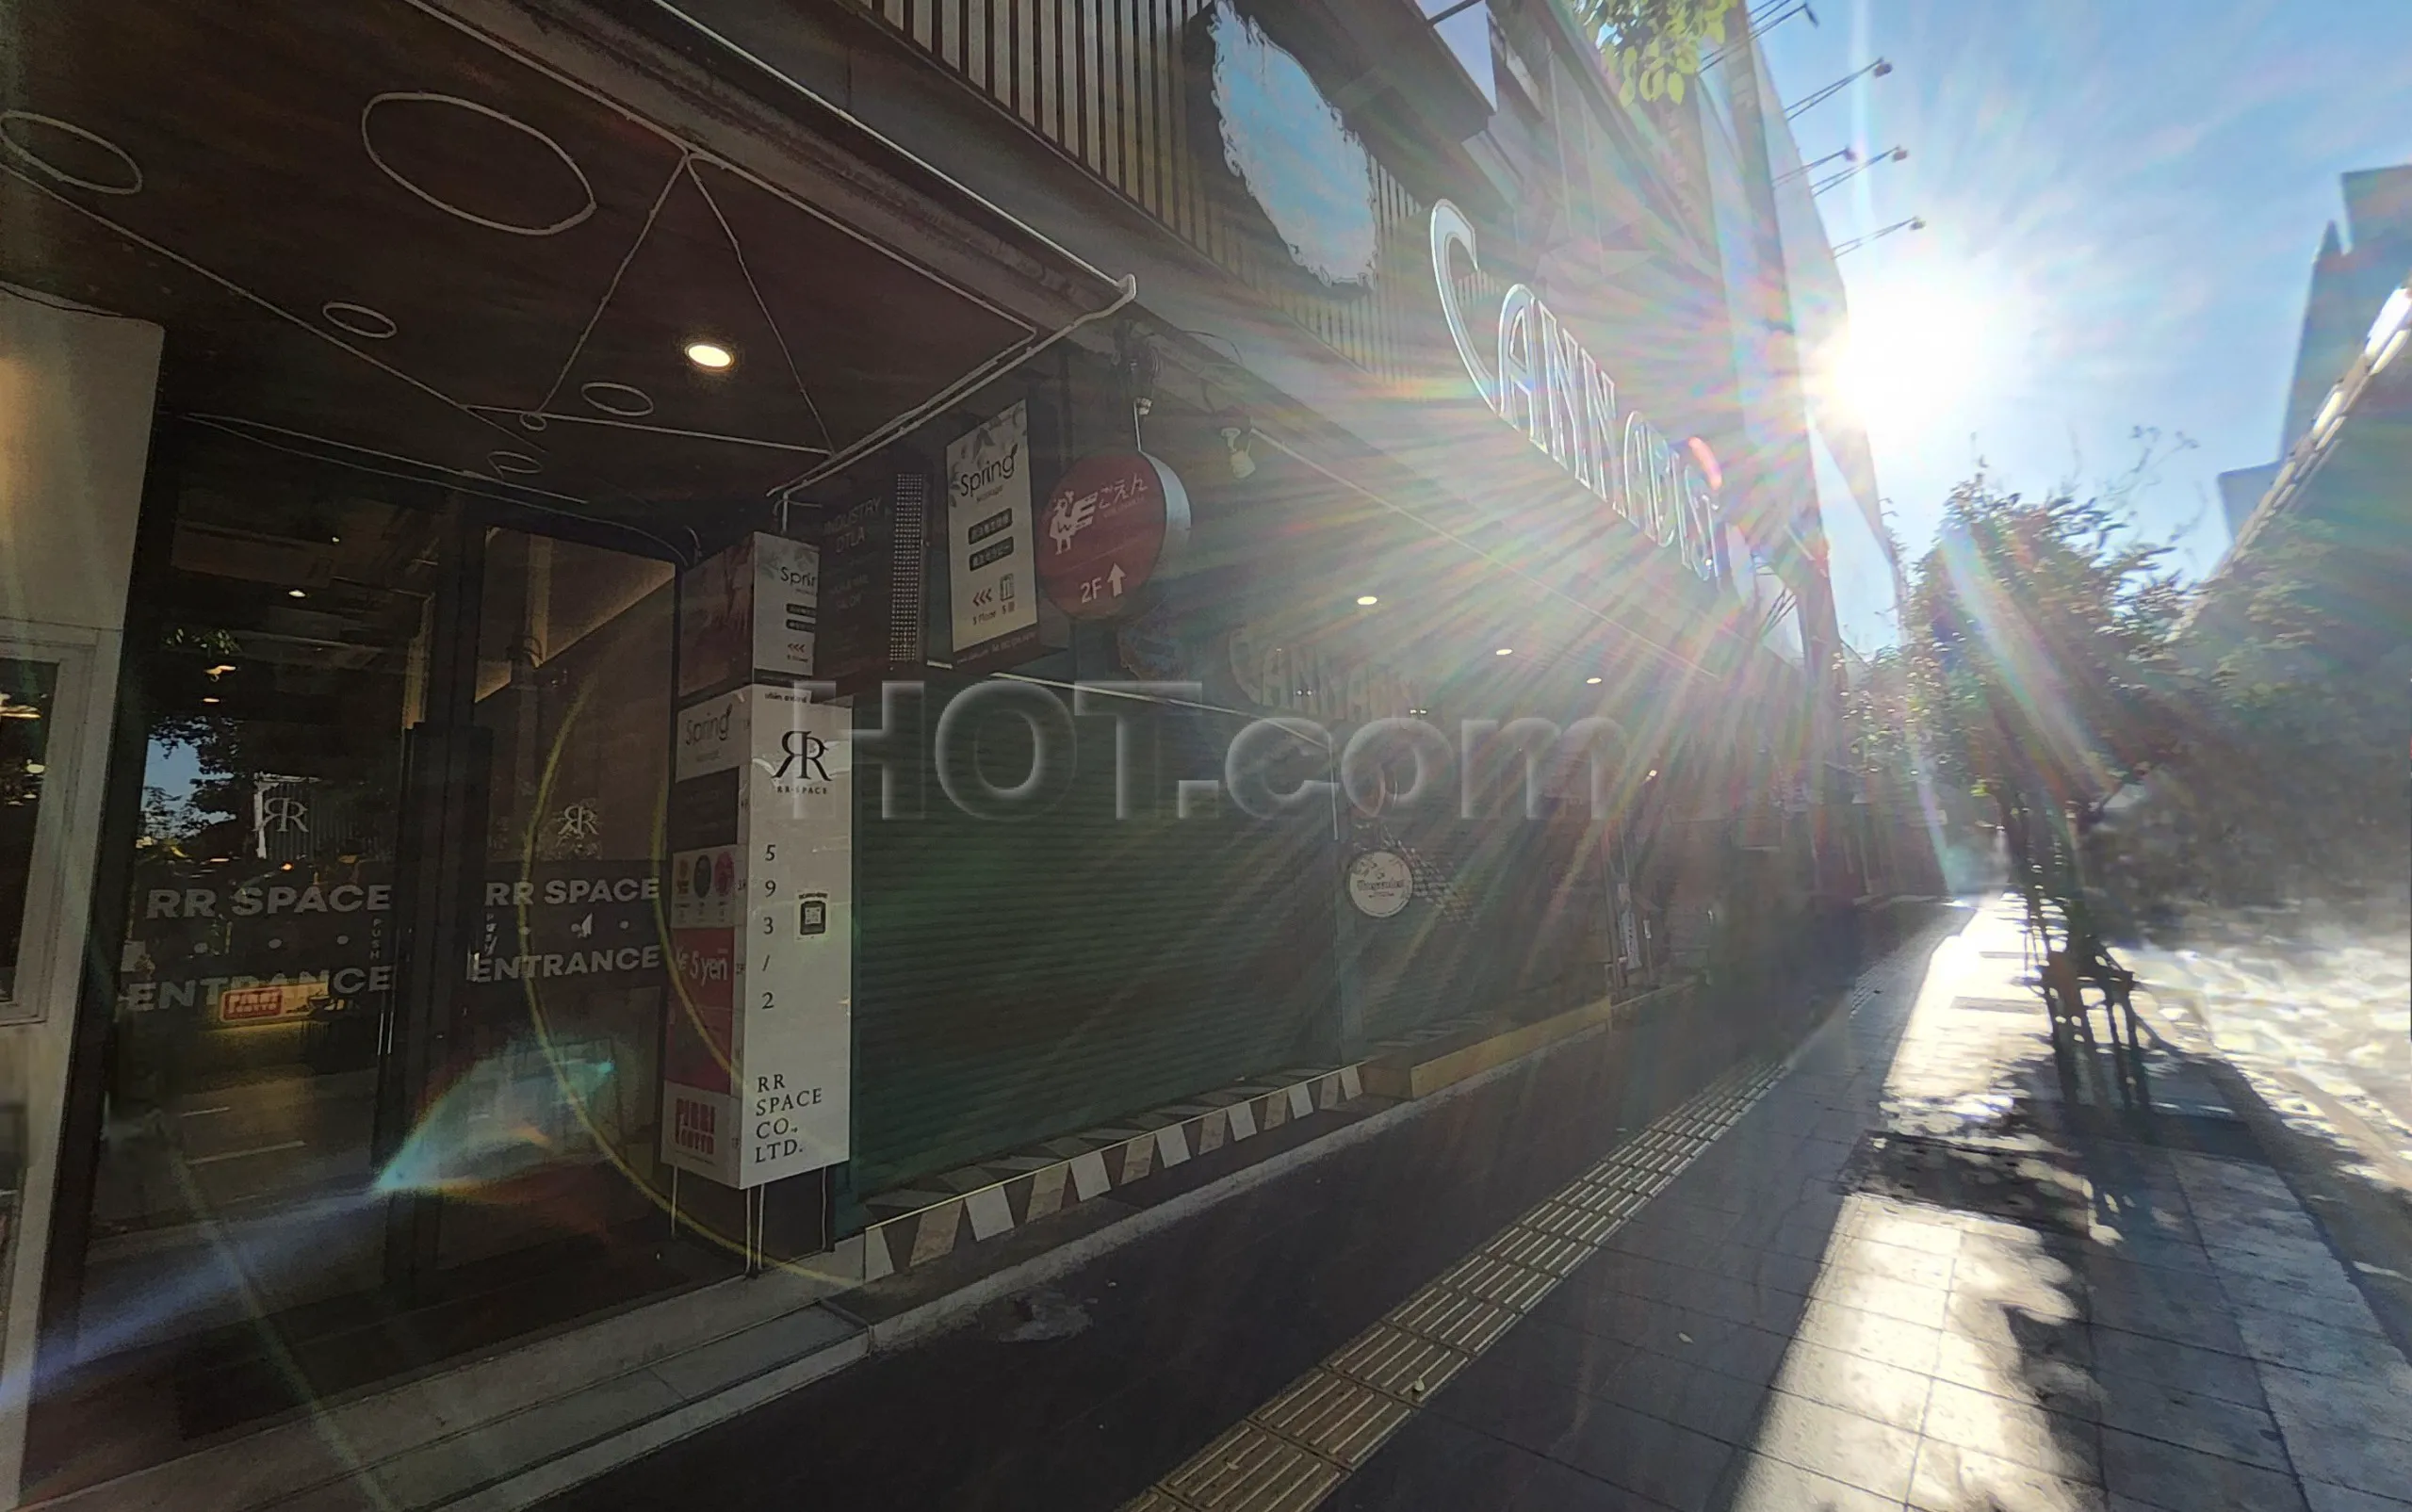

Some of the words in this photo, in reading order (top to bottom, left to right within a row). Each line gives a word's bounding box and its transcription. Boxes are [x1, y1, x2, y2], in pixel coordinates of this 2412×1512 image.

[960, 443, 1019, 497] Spring
[1080, 577, 1102, 604] 2F
[146, 888, 218, 919] RR
[230, 884, 393, 917] SPACE
[484, 881, 535, 906] RR
[544, 878, 660, 904] SPACE
[476, 945, 660, 983] ENTRANCE
[128, 966, 393, 1012] ENTCE
[757, 1073, 786, 1094] RR
[756, 1087, 823, 1116] SPACE
[755, 1139, 804, 1163] LTD.
